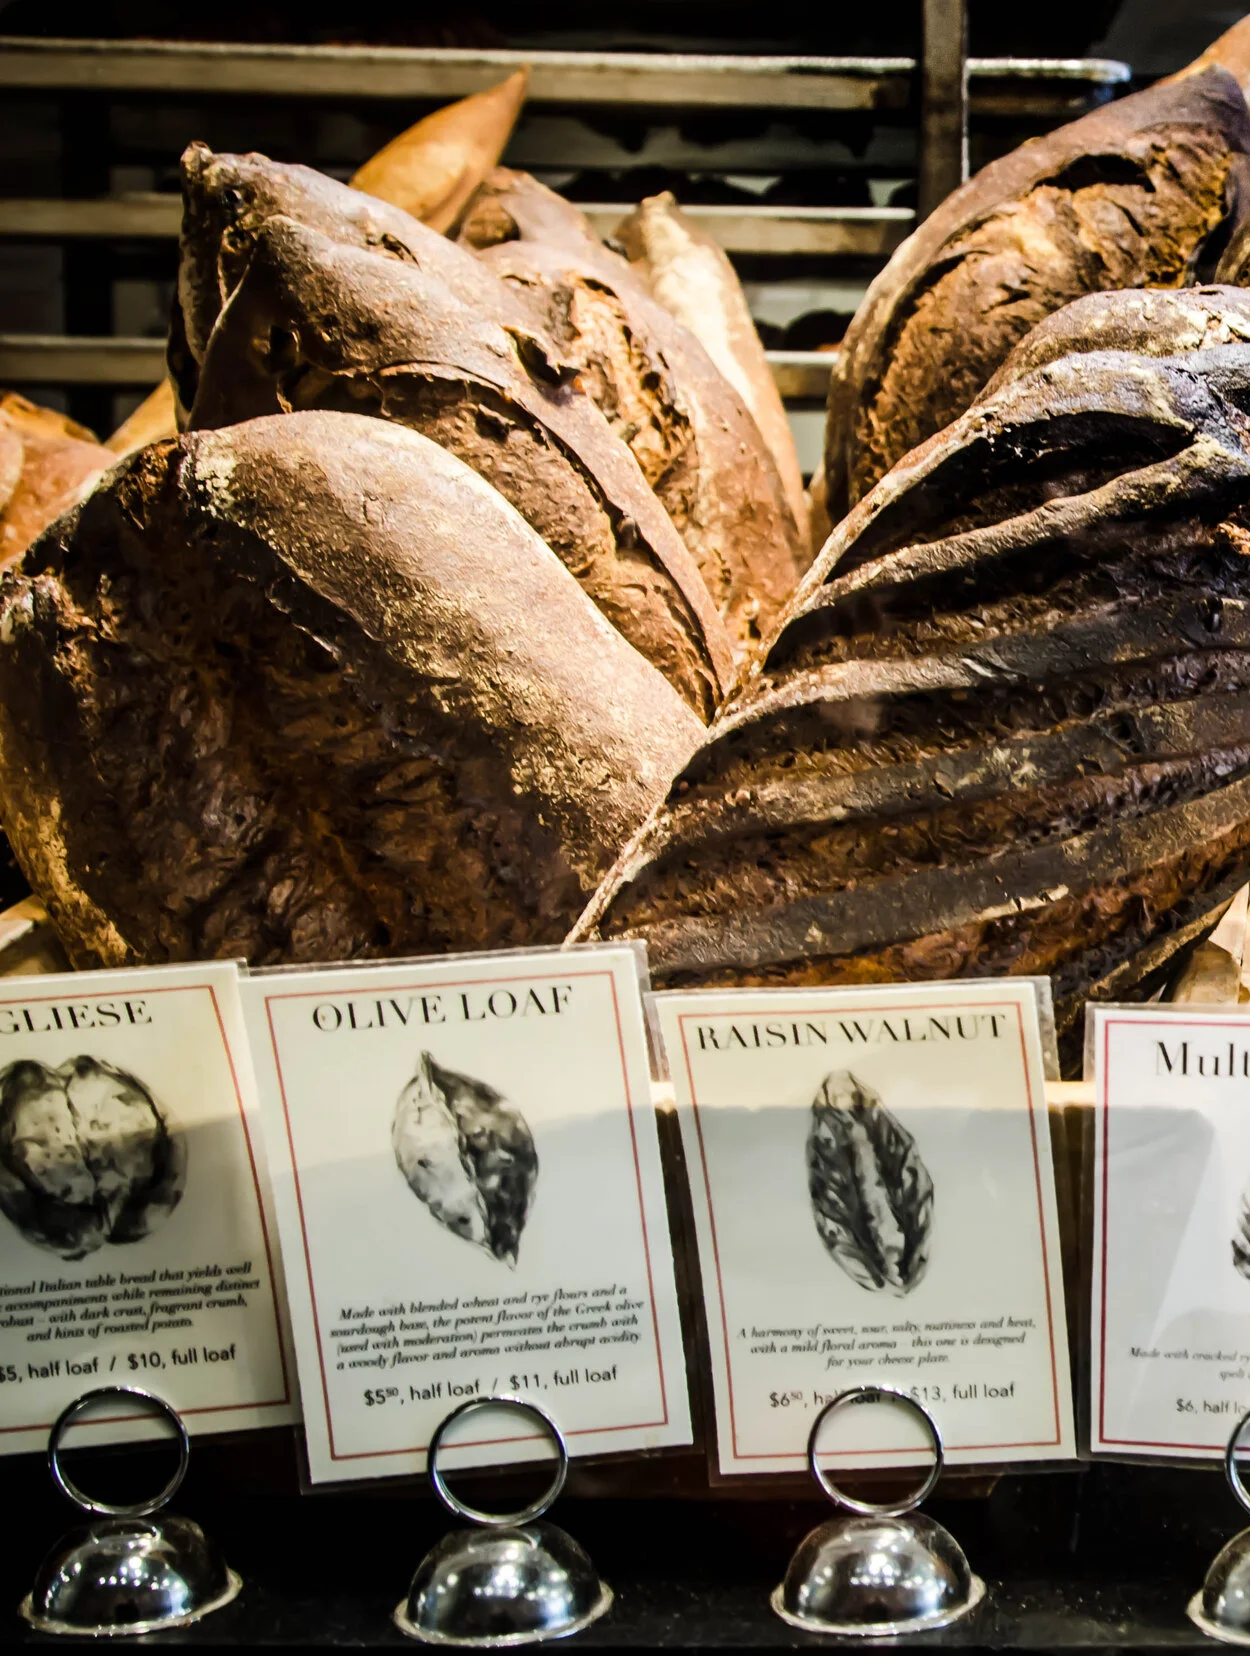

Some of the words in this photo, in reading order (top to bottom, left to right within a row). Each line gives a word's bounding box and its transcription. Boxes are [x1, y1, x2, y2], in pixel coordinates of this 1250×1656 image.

[312, 995, 446, 1032] OLIVE
[461, 985, 574, 1020] LOAF
[698, 1019, 828, 1050] RAISIN
[840, 1013, 1009, 1042] WALNUT
[38, 1279, 81, 1293] Italian
[85, 1275, 115, 1288] table
[119, 1271, 156, 1285] bread
[159, 1269, 184, 1281] that
[187, 1265, 222, 1282] yields
[225, 1261, 251, 1275] well
[5, 1293, 107, 1312] accompaniments
[112, 1288, 144, 1302] while
[148, 1284, 212, 1298] remaining
[215, 1279, 259, 1292] distinct
[49, 1310, 76, 1323] with
[80, 1307, 109, 1321] dark
[147, 1301, 202, 1319] fragrant
[339, 1307, 374, 1320] Made
[378, 1303, 406, 1316] with
[409, 1298, 458, 1314] blended
[462, 1296, 499, 1309] wheat
[503, 1292, 527, 1305] and
[531, 1294, 548, 1306] rye
[551, 1289, 588, 1305] flours
[592, 1284, 615, 1297] and
[619, 1287, 626, 1295] a
[26, 1329, 51, 1342] and
[54, 1327, 84, 1339] hints
[87, 1324, 101, 1339] of
[103, 1319, 149, 1334] roasted
[329, 1320, 396, 1337] sourdough
[431, 1316, 452, 1328] the
[454, 1312, 493, 1329] potent
[494, 1310, 534, 1326] flavor
[536, 1305, 551, 1321] of
[551, 1304, 572, 1317] the
[574, 1300, 612, 1314] Greek
[614, 1298, 644, 1311] olive
[336, 1340, 368, 1358] (used
[371, 1337, 399, 1350] with
[402, 1329, 477, 1347] moderation)
[480, 1325, 543, 1344] permeates
[546, 1321, 565, 1333] the
[568, 1316, 607, 1331] crumb
[611, 1313, 638, 1327] with
[336, 1362, 345, 1370] a
[348, 1355, 387, 1369] woody
[390, 1353, 427, 1369] flavor
[432, 1347, 456, 1360] and
[459, 1347, 500, 1358] aroma
[504, 1339, 550, 1353] without
[554, 1335, 595, 1349] abrupt
[27, 1361, 59, 1380] half
[65, 1357, 98, 1376] loaf
[171, 1347, 197, 1364] full
[203, 1343, 235, 1361] loaf
[409, 1384, 441, 1401] half
[447, 1380, 479, 1398] loaf
[552, 1370, 579, 1387] full
[584, 1366, 616, 1384] loaf
[953, 1384, 977, 1399] full
[984, 1382, 1015, 1398] loaf
[1203, 1400, 1229, 1414] half
